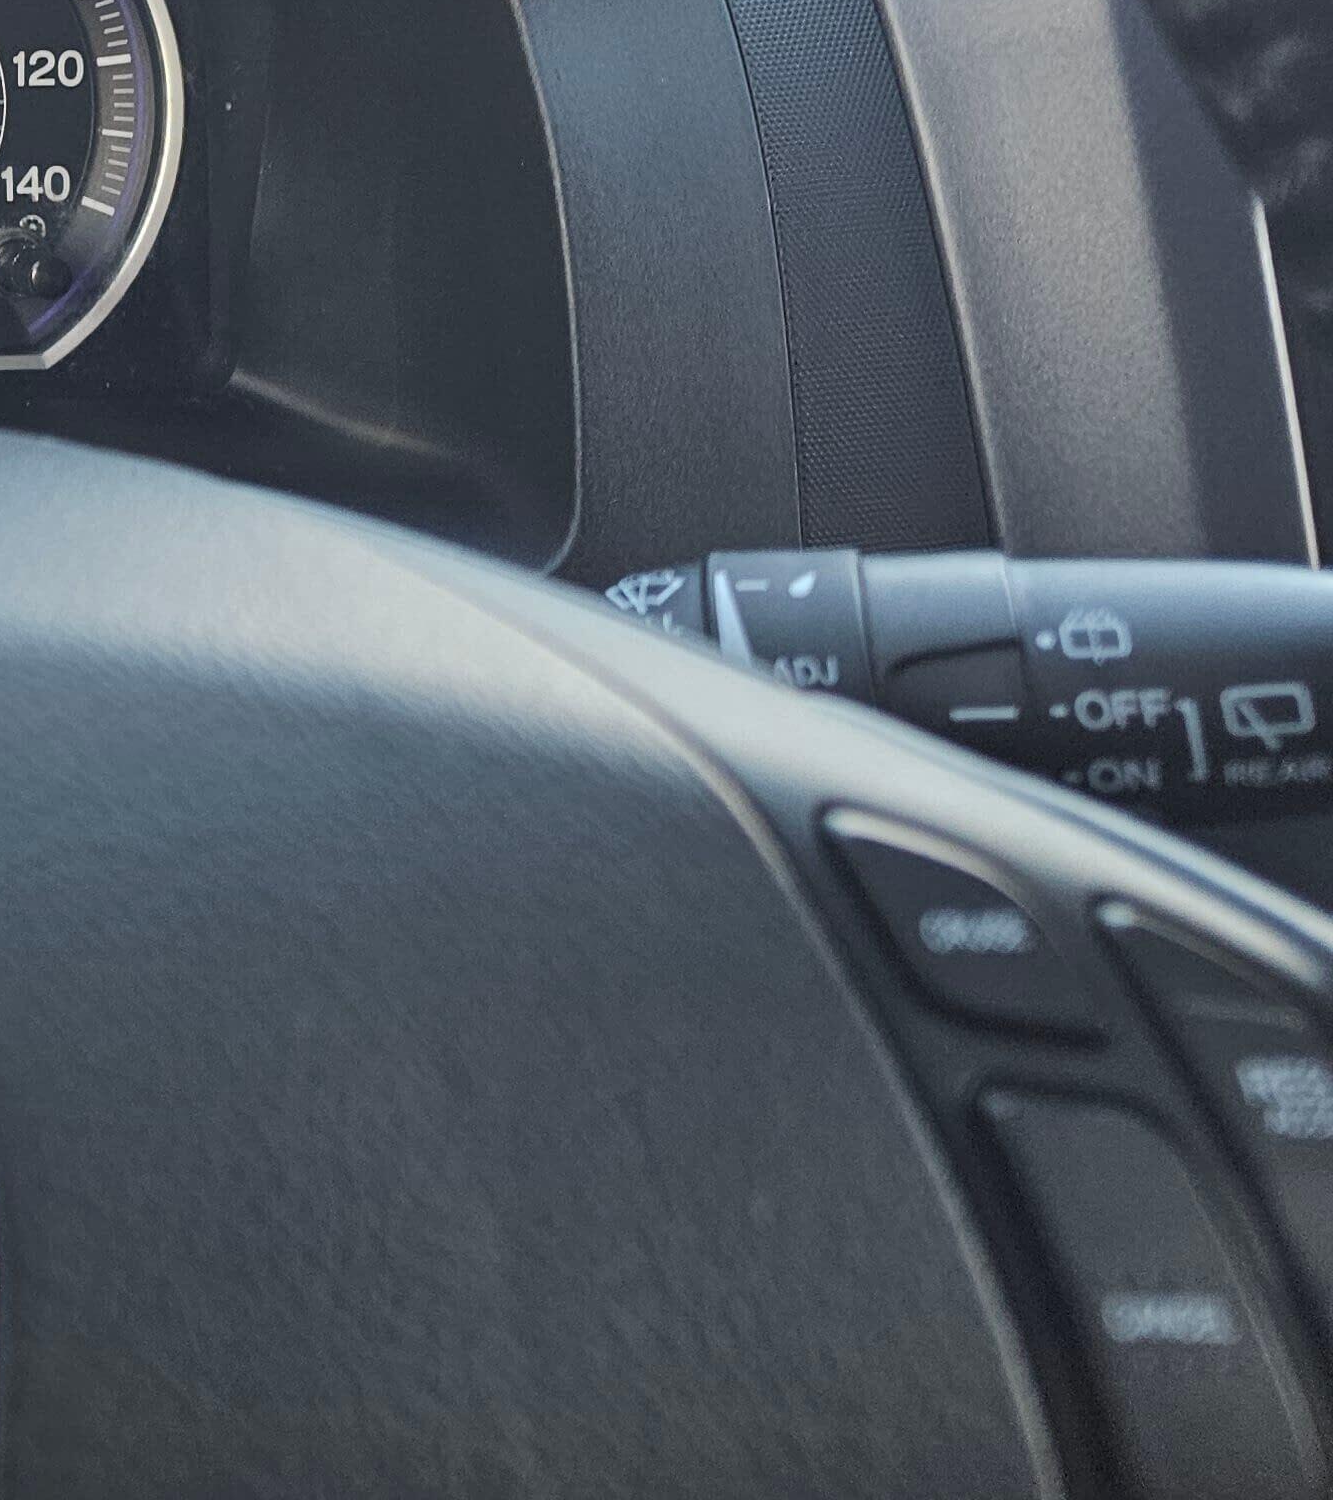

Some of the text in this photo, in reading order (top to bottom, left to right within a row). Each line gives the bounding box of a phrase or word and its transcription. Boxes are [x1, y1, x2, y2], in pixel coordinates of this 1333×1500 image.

[12, 49, 85, 88] 120
[0, 165, 71, 203] 140
[1074, 688, 1173, 731] OFF
[1087, 755, 1162, 792] ON
